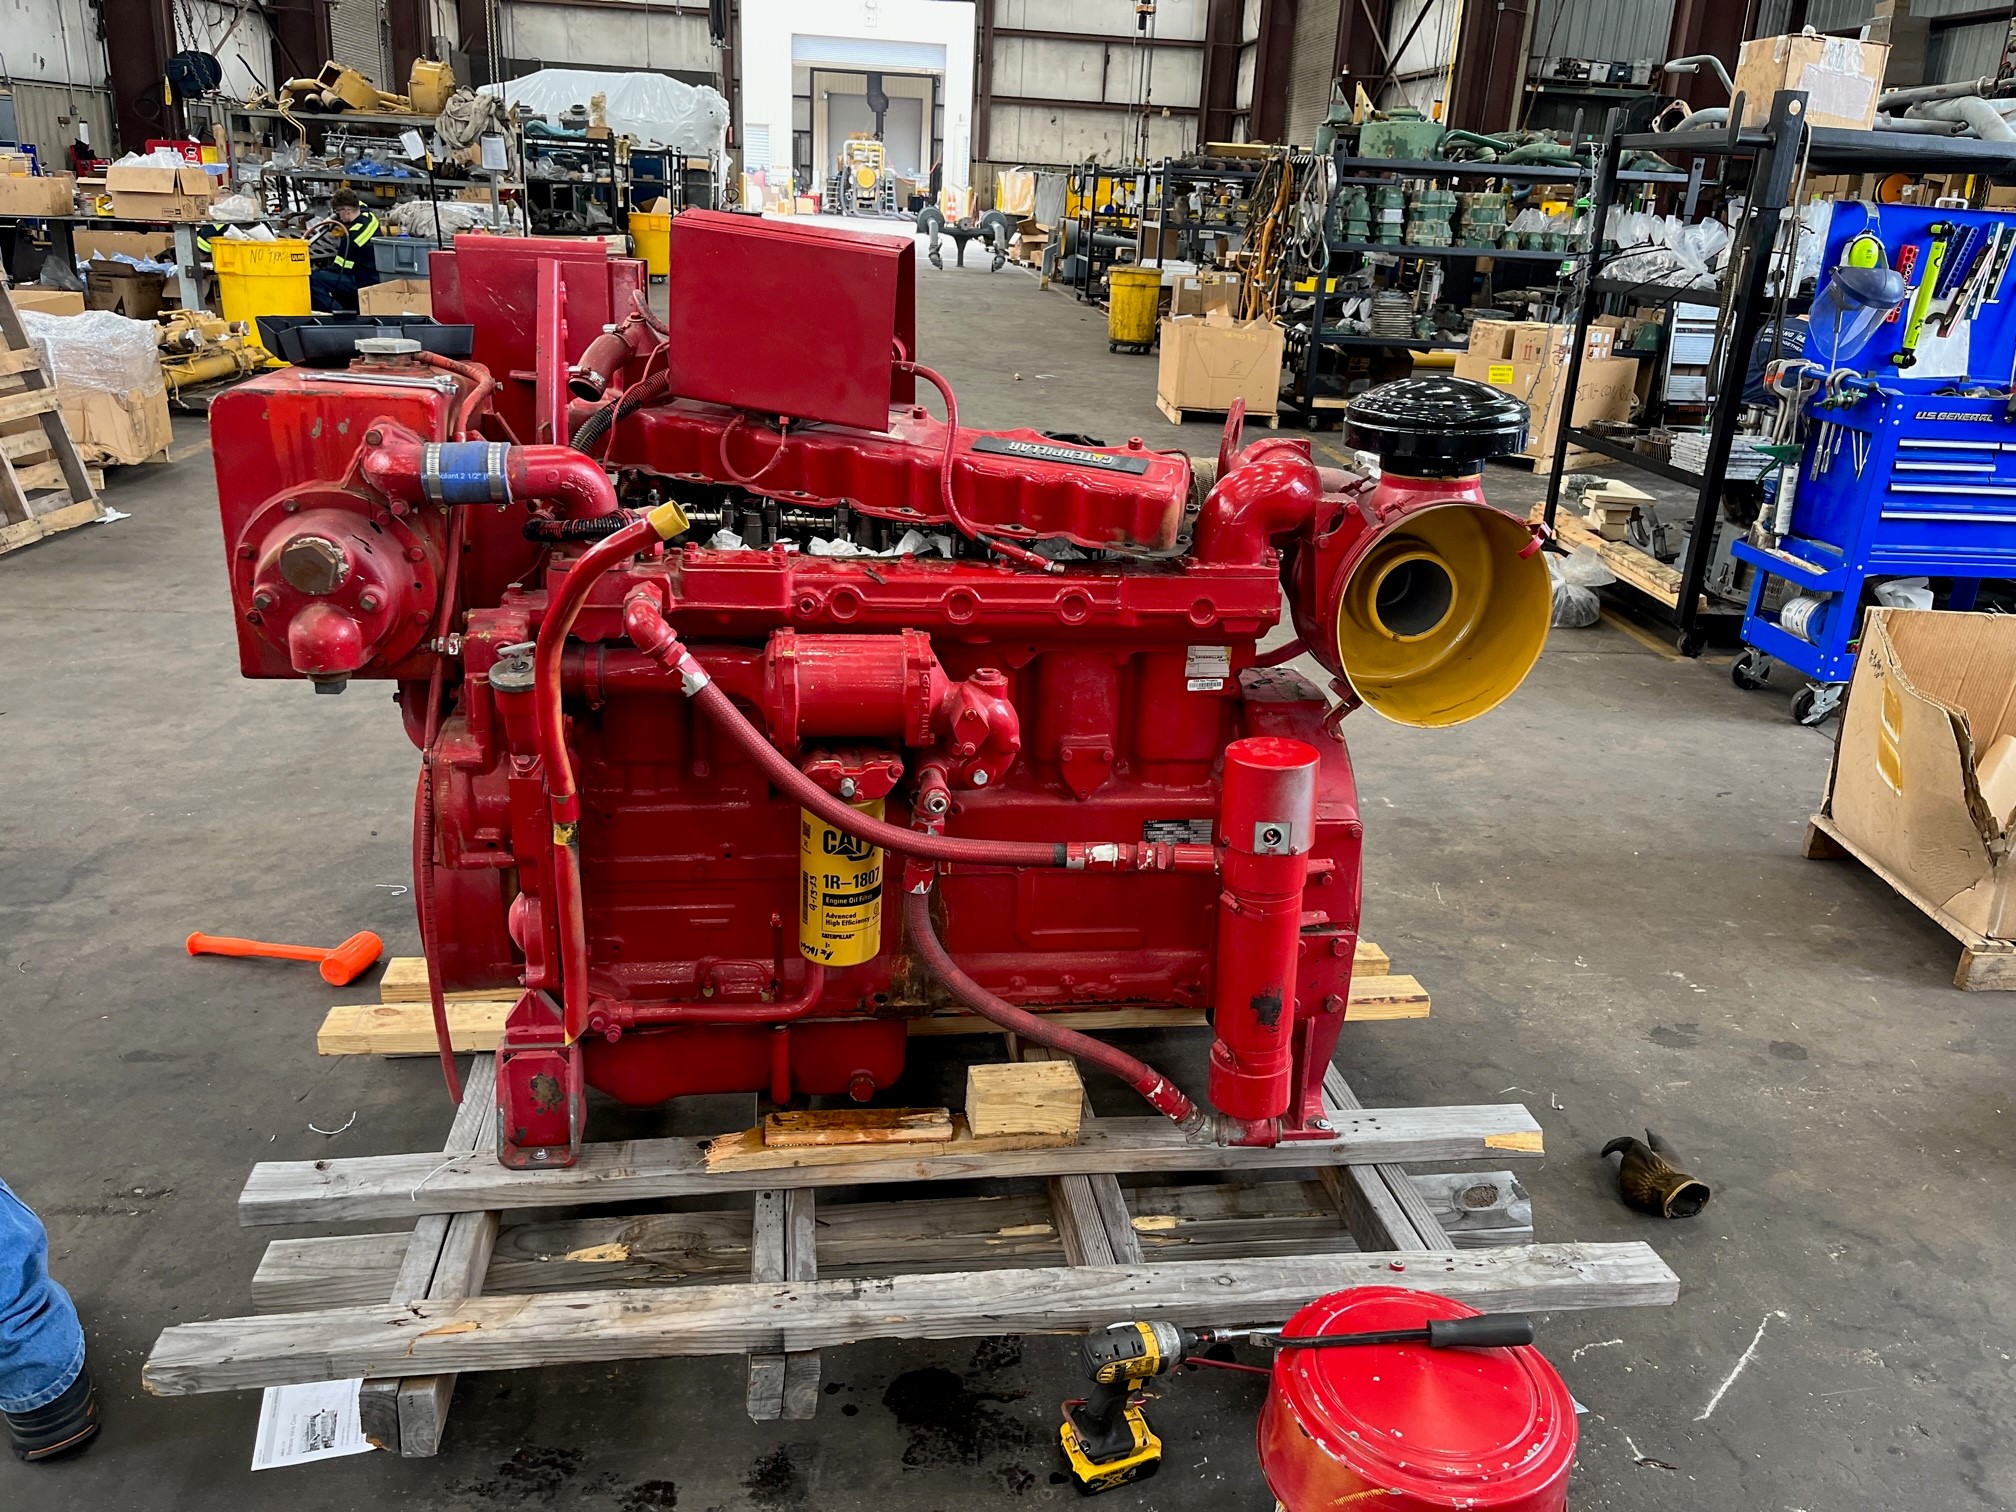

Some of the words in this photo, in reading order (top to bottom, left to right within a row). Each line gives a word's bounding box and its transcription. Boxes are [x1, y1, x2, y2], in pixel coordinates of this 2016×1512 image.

[249, 248, 263, 263] NO
[1007, 441, 1113, 465] CATERPILLAR
[823, 866, 880, 890] 1R-1807
[825, 896, 848, 906] Engine
[825, 912, 857, 920] Advanced
[825, 919, 841, 928] High
[841, 916, 871, 927] Efficiency
